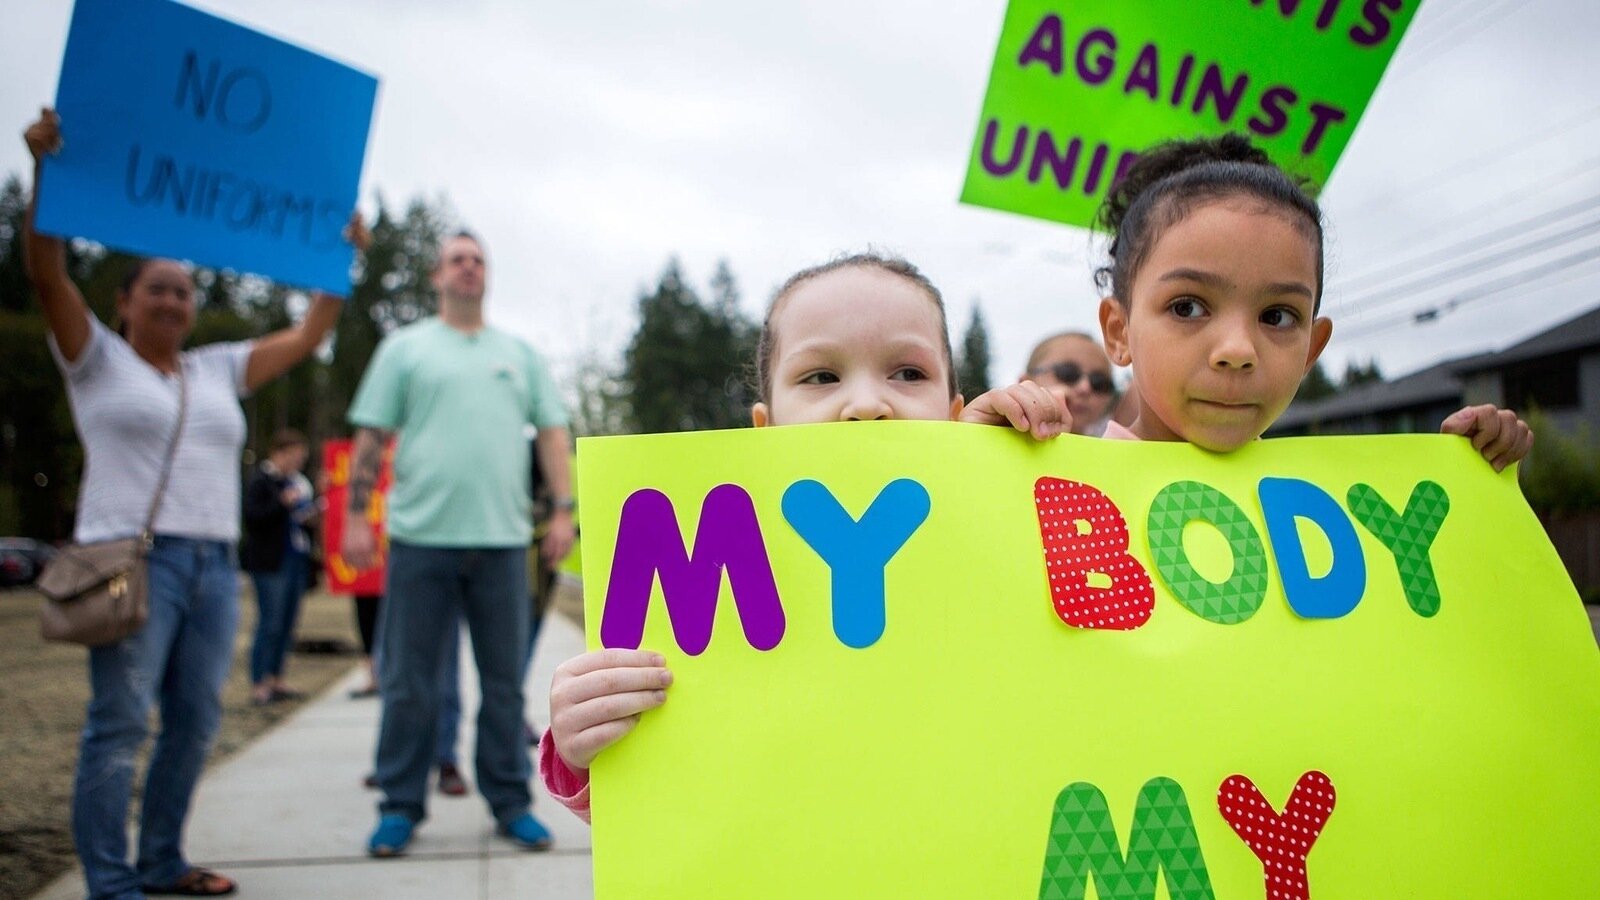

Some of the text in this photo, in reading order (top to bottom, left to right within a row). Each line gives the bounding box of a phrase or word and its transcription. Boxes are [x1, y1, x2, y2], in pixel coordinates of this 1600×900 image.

[173, 47, 273, 135] NO
[1018, 13, 1346, 155] AGAINST
[125, 142, 350, 252] UNIFORMS
[600, 476, 1450, 656] MY BODY
[1038, 770, 1337, 900] MY
